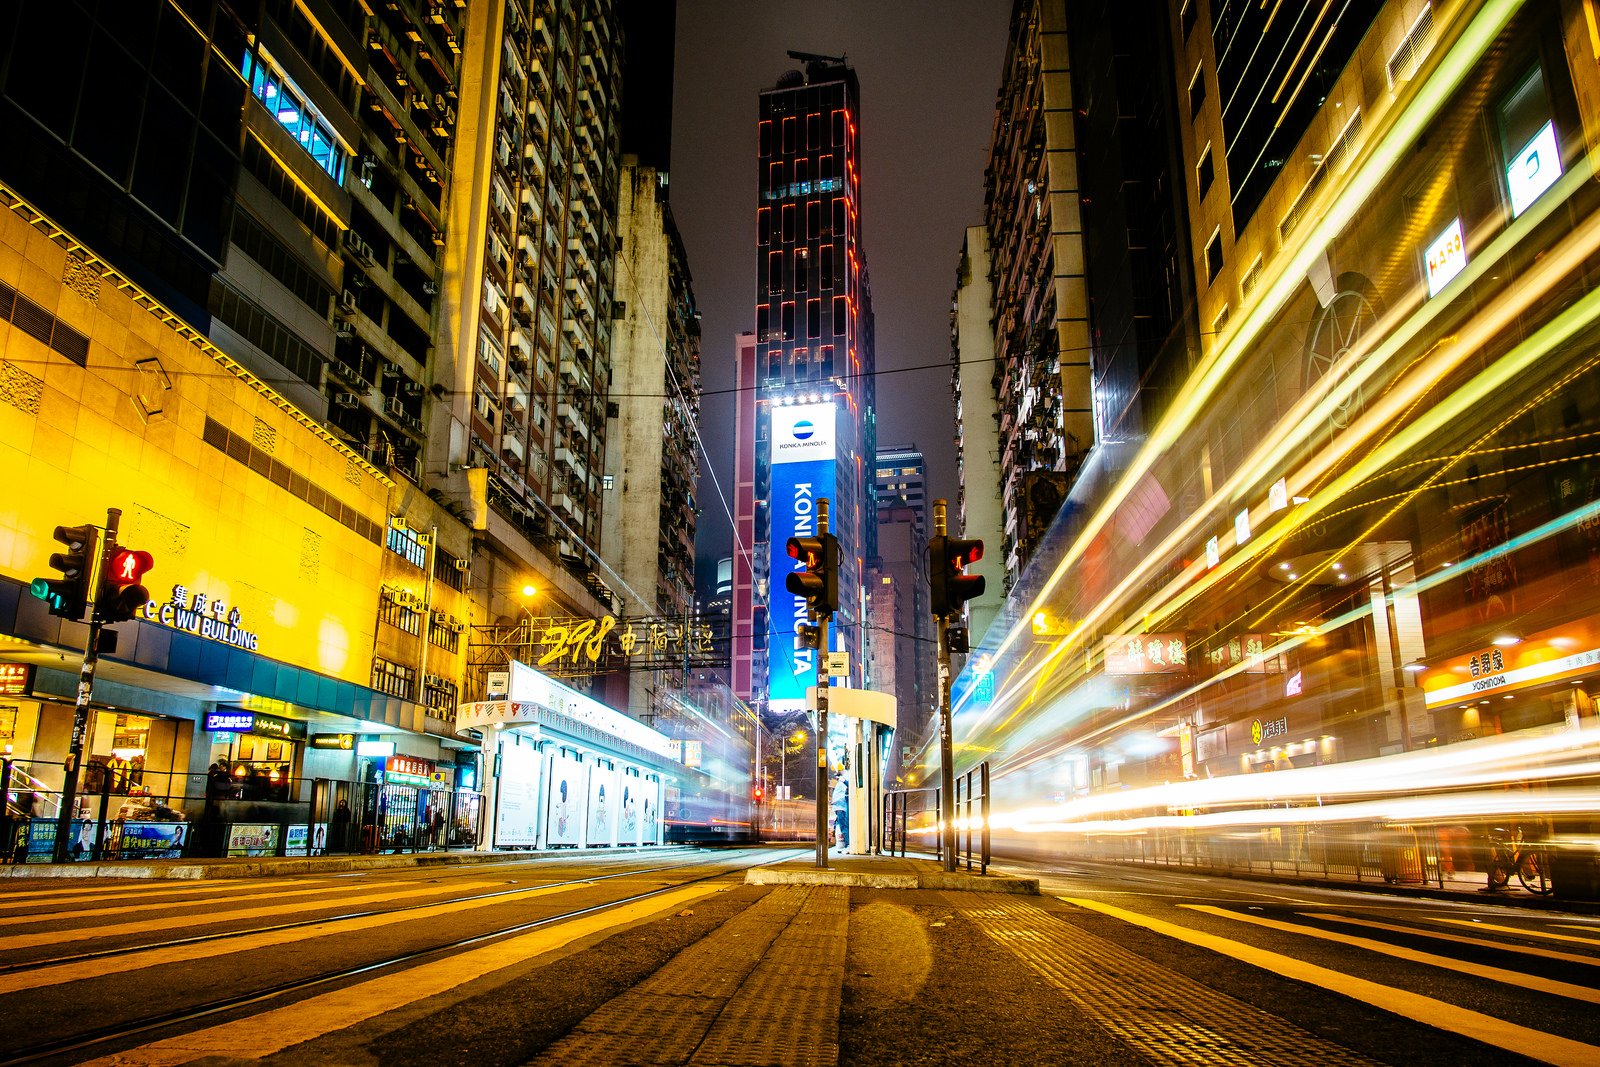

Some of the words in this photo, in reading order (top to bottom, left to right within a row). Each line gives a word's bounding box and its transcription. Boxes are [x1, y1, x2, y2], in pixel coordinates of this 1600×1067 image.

[802, 440, 827, 448] MINOLTA
[794, 483, 812, 571] KONI
[173, 584, 241, 626] 集成中心
[160, 605, 173, 624] C
[176, 608, 200, 632] WU
[202, 617, 258, 650] BUILDING
[538, 615, 615, 666] 298
[1469, 648, 1504, 678] 吉野家
[1472, 675, 1506, 691] YOSHINOYA
